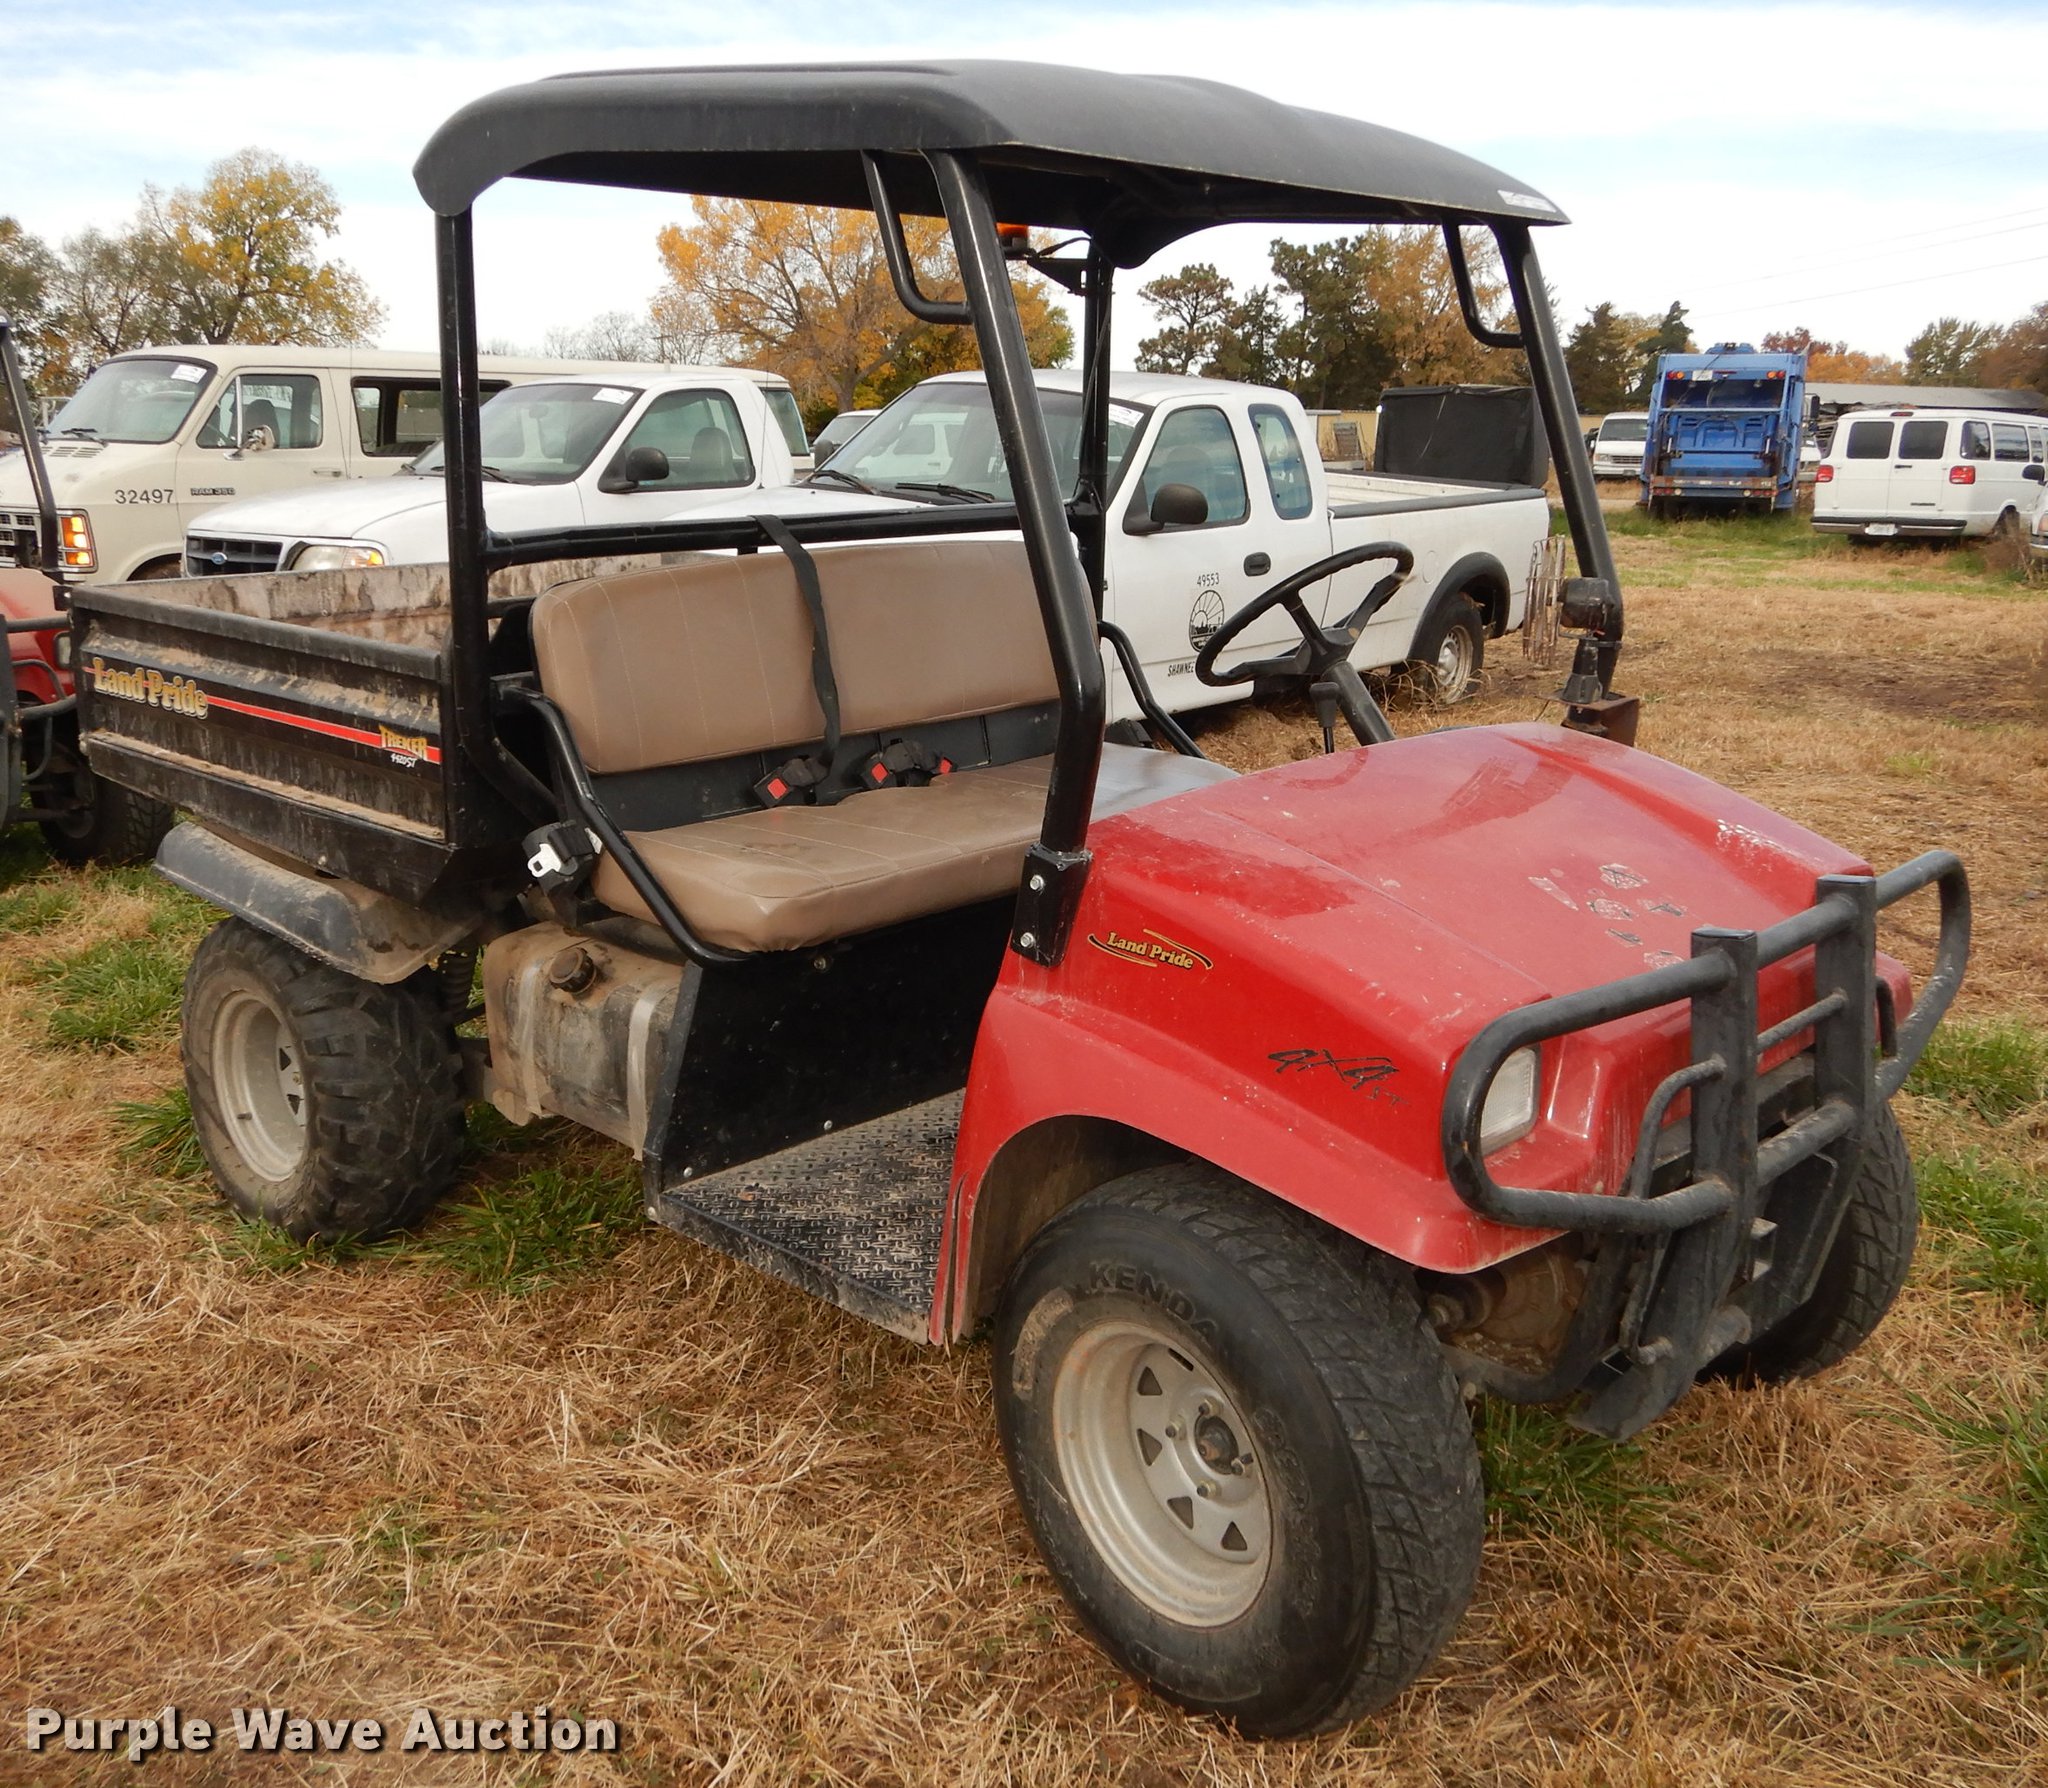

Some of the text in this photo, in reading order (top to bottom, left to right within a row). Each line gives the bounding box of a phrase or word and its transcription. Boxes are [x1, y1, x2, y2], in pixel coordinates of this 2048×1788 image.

[114, 488, 174, 504] 32497
[1196, 572, 1220, 587] 49553
[93, 656, 208, 719] Land Pride
[1106, 931, 1194, 970] Land Pride
[1088, 1260, 1219, 1350] KENDA
